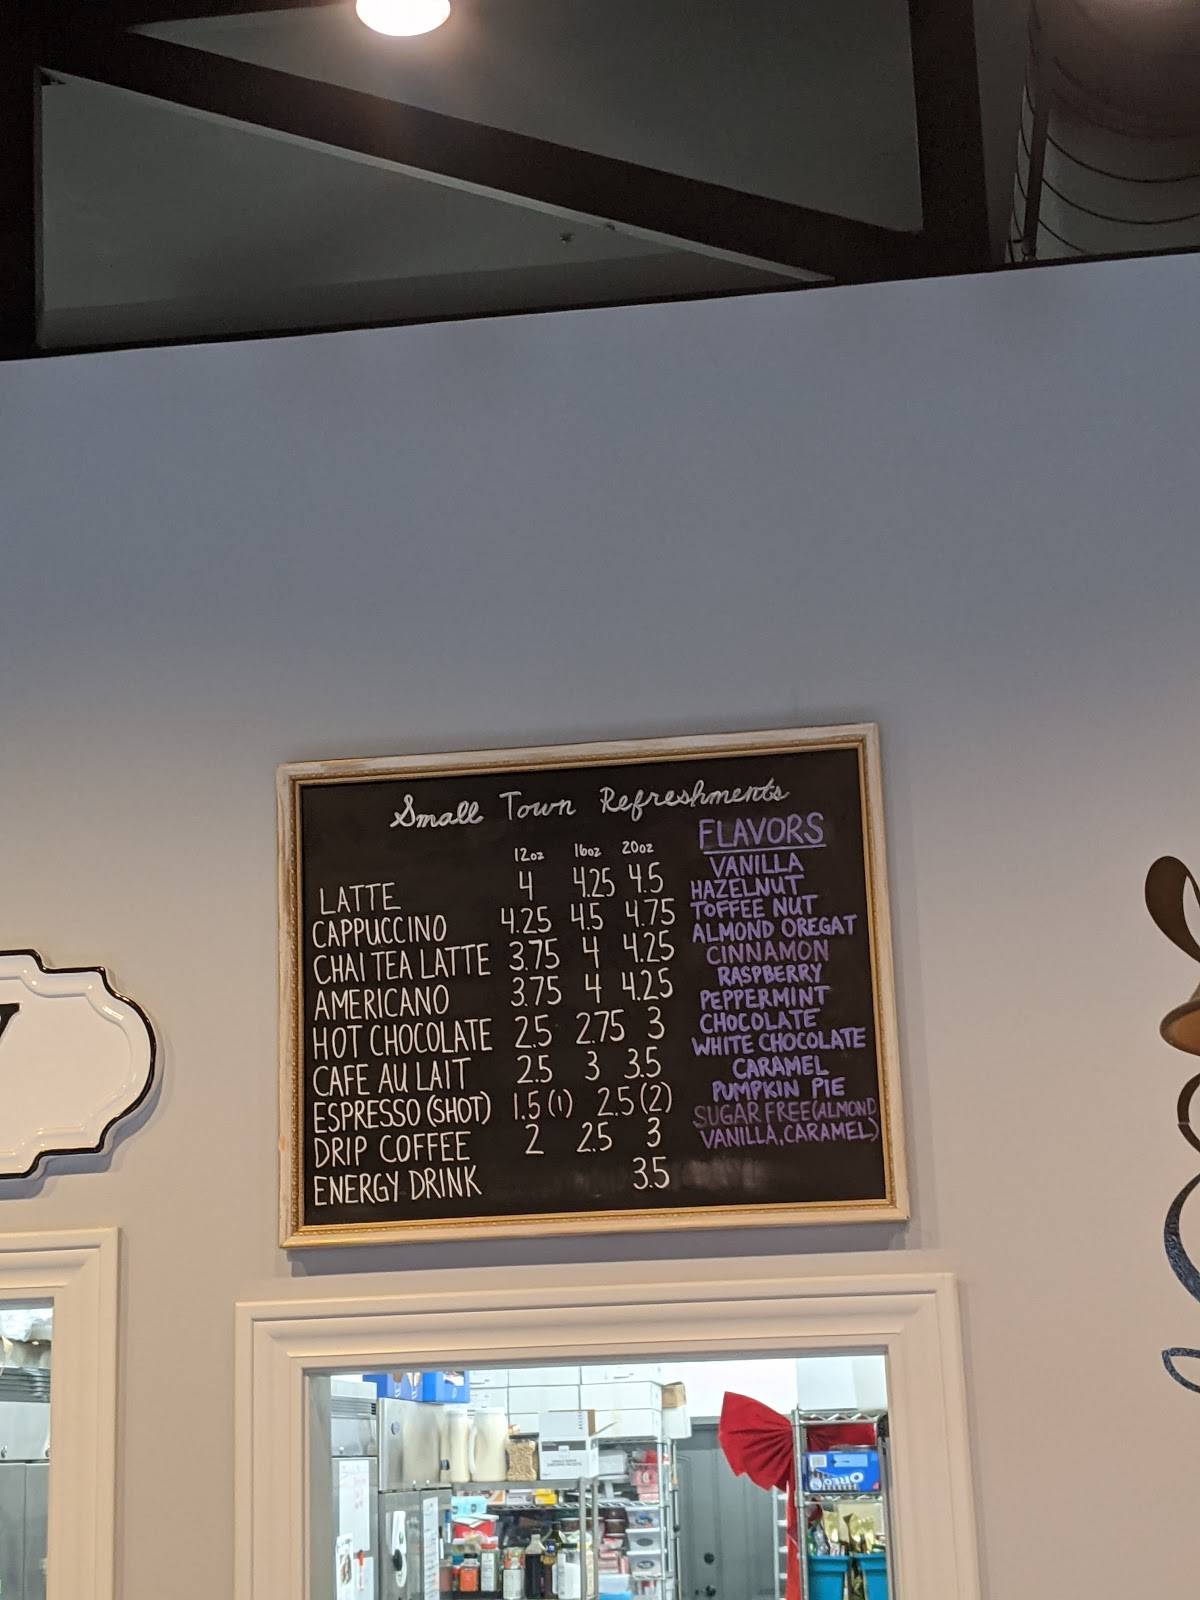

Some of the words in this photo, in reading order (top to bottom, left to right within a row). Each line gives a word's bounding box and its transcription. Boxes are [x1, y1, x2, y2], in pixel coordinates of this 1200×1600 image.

[390, 795, 484, 827] Small
[499, 791, 576, 820] Town
[600, 779, 790, 821] Refreshments
[699, 812, 824, 849] FLAVORS
[514, 847, 544, 862] 12oz
[574, 843, 602, 857] 16oz
[622, 841, 654, 854] 20oz
[709, 852, 804, 878] VANILLA
[320, 882, 401, 915] LATTE
[519, 871, 533, 901] 4
[573, 866, 616, 898] 4.25
[628, 862, 664, 894] 4.5
[691, 874, 804, 900] HAZELNUT
[690, 898, 766, 920] TOFFEE
[772, 894, 819, 918] NUT
[312, 914, 447, 948] CAPPUCCINO
[501, 906, 552, 934] 4.25
[570, 902, 603, 931] 4.5
[625, 898, 676, 928] 4.75
[692, 919, 775, 943] ALMOND
[781, 914, 857, 938] OREGAT
[313, 952, 366, 985] CHAI
[371, 950, 413, 981] TEA
[420, 943, 492, 980] LATTE
[509, 937, 560, 971] 3.75
[582, 936, 600, 969] 4
[623, 930, 675, 963] 4.25
[706, 939, 829, 965] CINNAMON
[717, 963, 822, 987] RASPBERRY
[314, 984, 449, 1021] AMERICANO
[510, 976, 562, 1007] 3.75
[585, 973, 602, 1004] 4
[621, 967, 673, 1001] 4.25
[700, 985, 832, 1011] PEPPERMINT
[312, 1025, 363, 1061] HOT
[370, 1018, 493, 1057] CHOCOLATE
[514, 1014, 552, 1048] 2.5
[576, 1009, 625, 1045] 2.75
[647, 1006, 665, 1039] 3
[700, 1008, 821, 1034] CHOCOLATE
[691, 1035, 755, 1057] WHITE
[758, 1027, 867, 1052] CHOCOLATE
[313, 1064, 370, 1097] CAFE
[378, 1062, 408, 1094] AU
[416, 1057, 471, 1091] LAIT
[516, 1054, 553, 1084] 2.5
[584, 1050, 600, 1081] 3
[624, 1046, 661, 1079] 3.5
[732, 1055, 830, 1080] CARAMEL
[712, 1079, 800, 1102] PUMPKIN
[811, 1076, 846, 1099] PIE
[314, 1098, 421, 1134] ESPRESSO
[426, 1090, 492, 1127] (SHOT)
[513, 1090, 541, 1120] 1.5
[597, 1086, 634, 1117] 2.5
[640, 1081, 673, 1114] (2)
[692, 1103, 762, 1128] SUGAR
[314, 1136, 368, 1168] DRIP
[379, 1131, 472, 1163] COFFEE
[524, 1123, 544, 1155] 2
[576, 1121, 613, 1152] 2.5
[646, 1117, 662, 1148] 3
[314, 1171, 399, 1206] ENERGY
[409, 1165, 483, 1200] DRINK
[632, 1156, 670, 1190] 3.5
